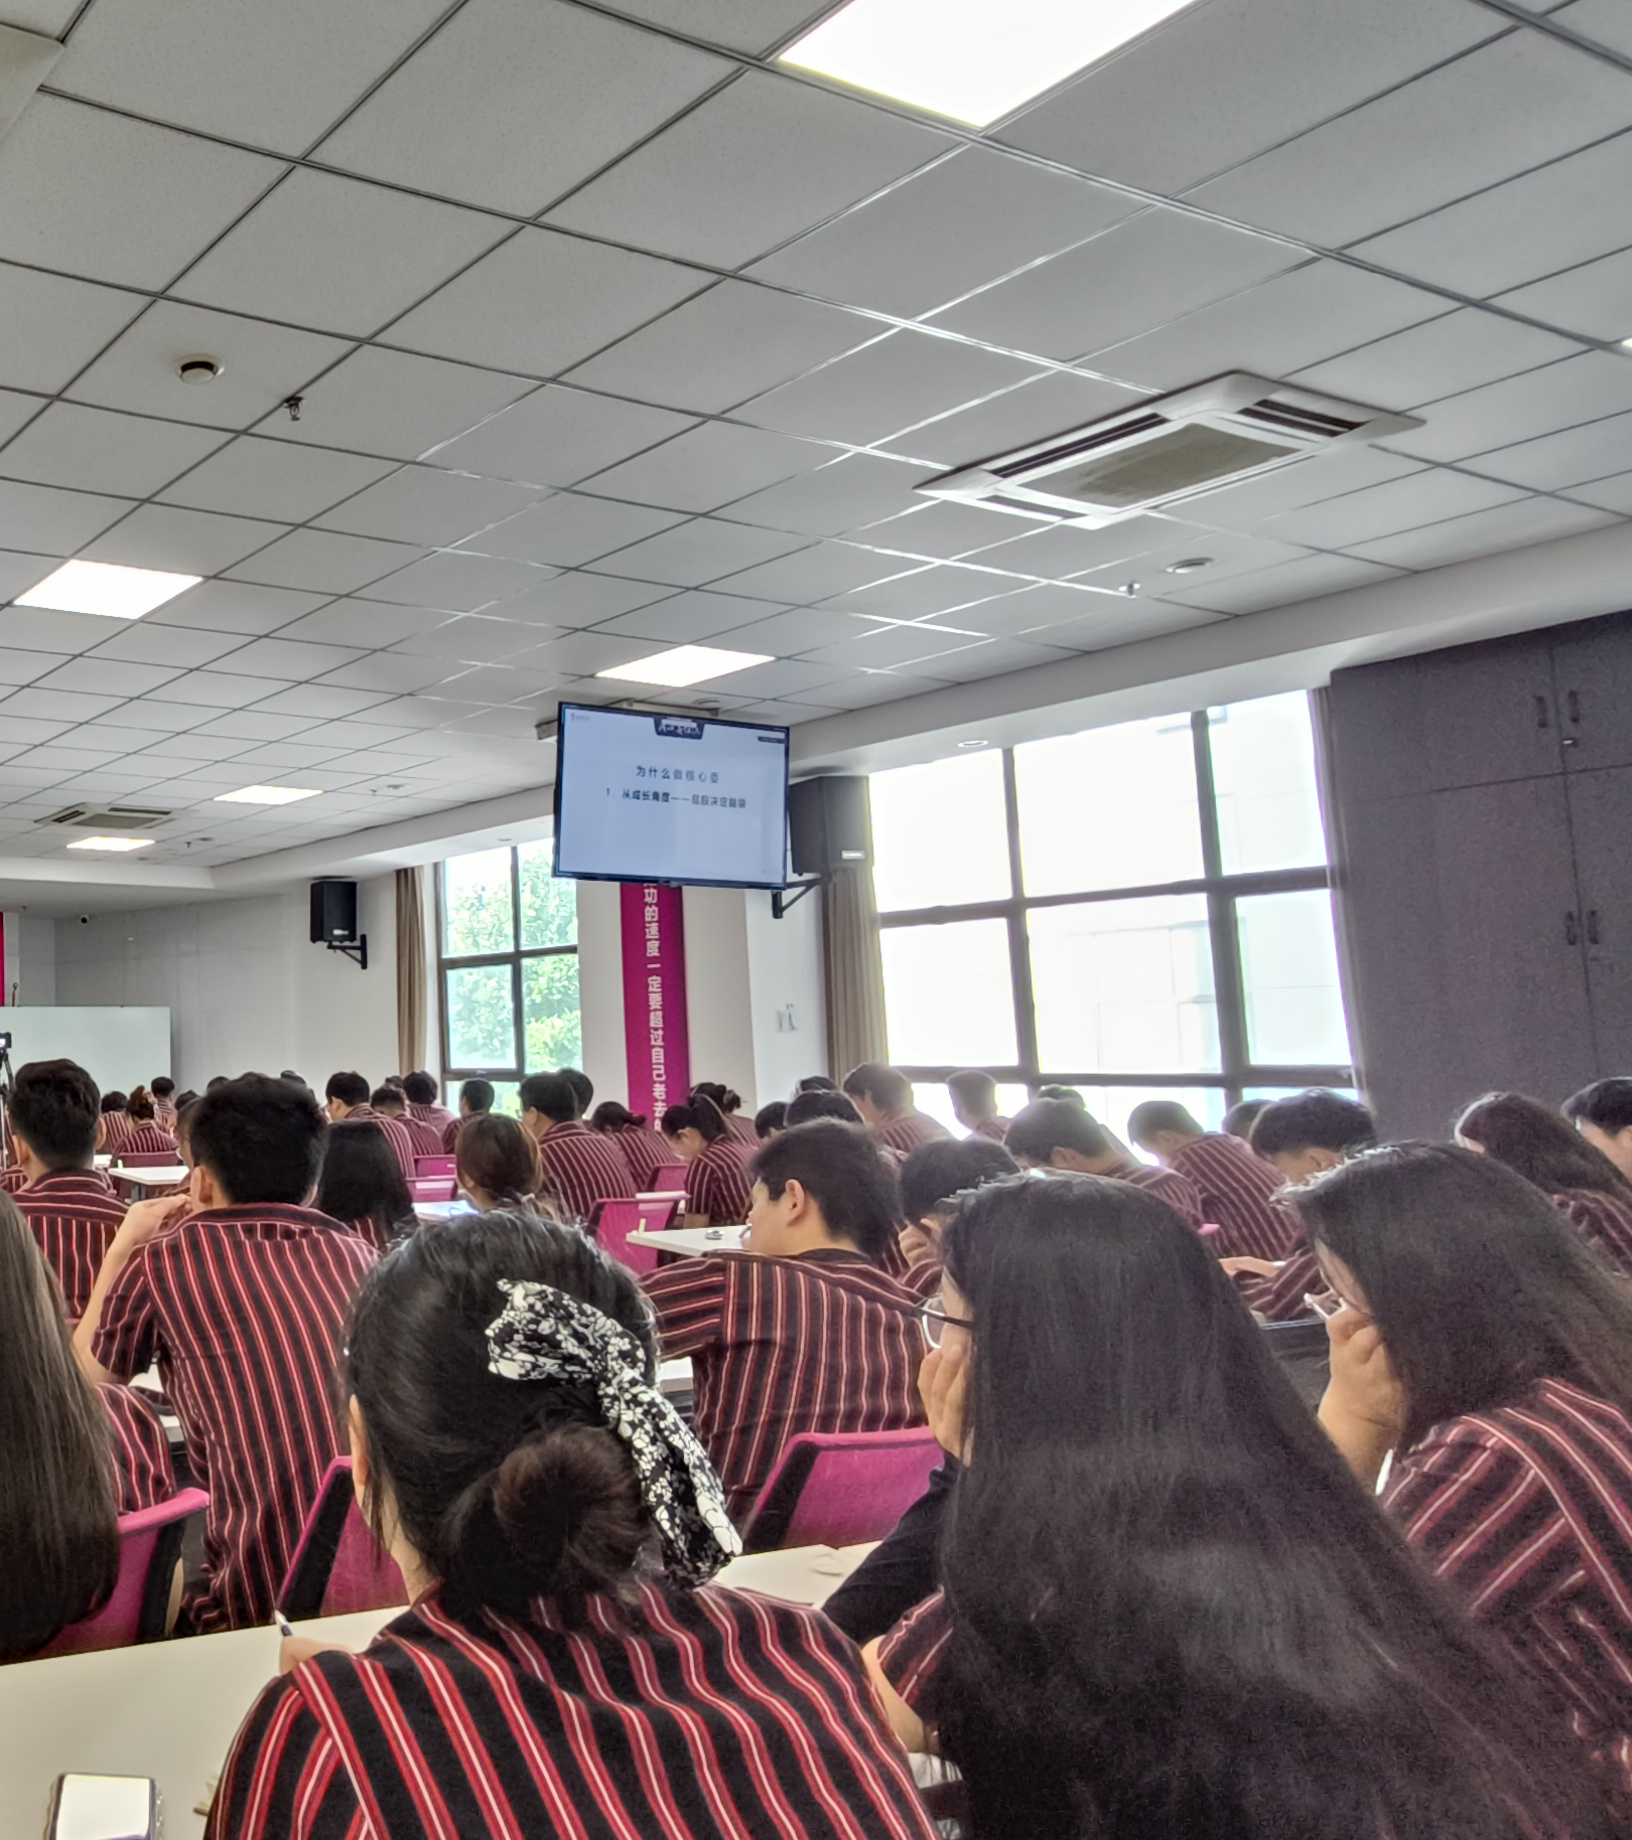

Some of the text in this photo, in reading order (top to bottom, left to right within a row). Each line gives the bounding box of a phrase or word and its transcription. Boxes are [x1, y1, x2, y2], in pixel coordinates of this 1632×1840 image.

[643, 883, 668, 1131] 功的速度一定要超过自己老去
